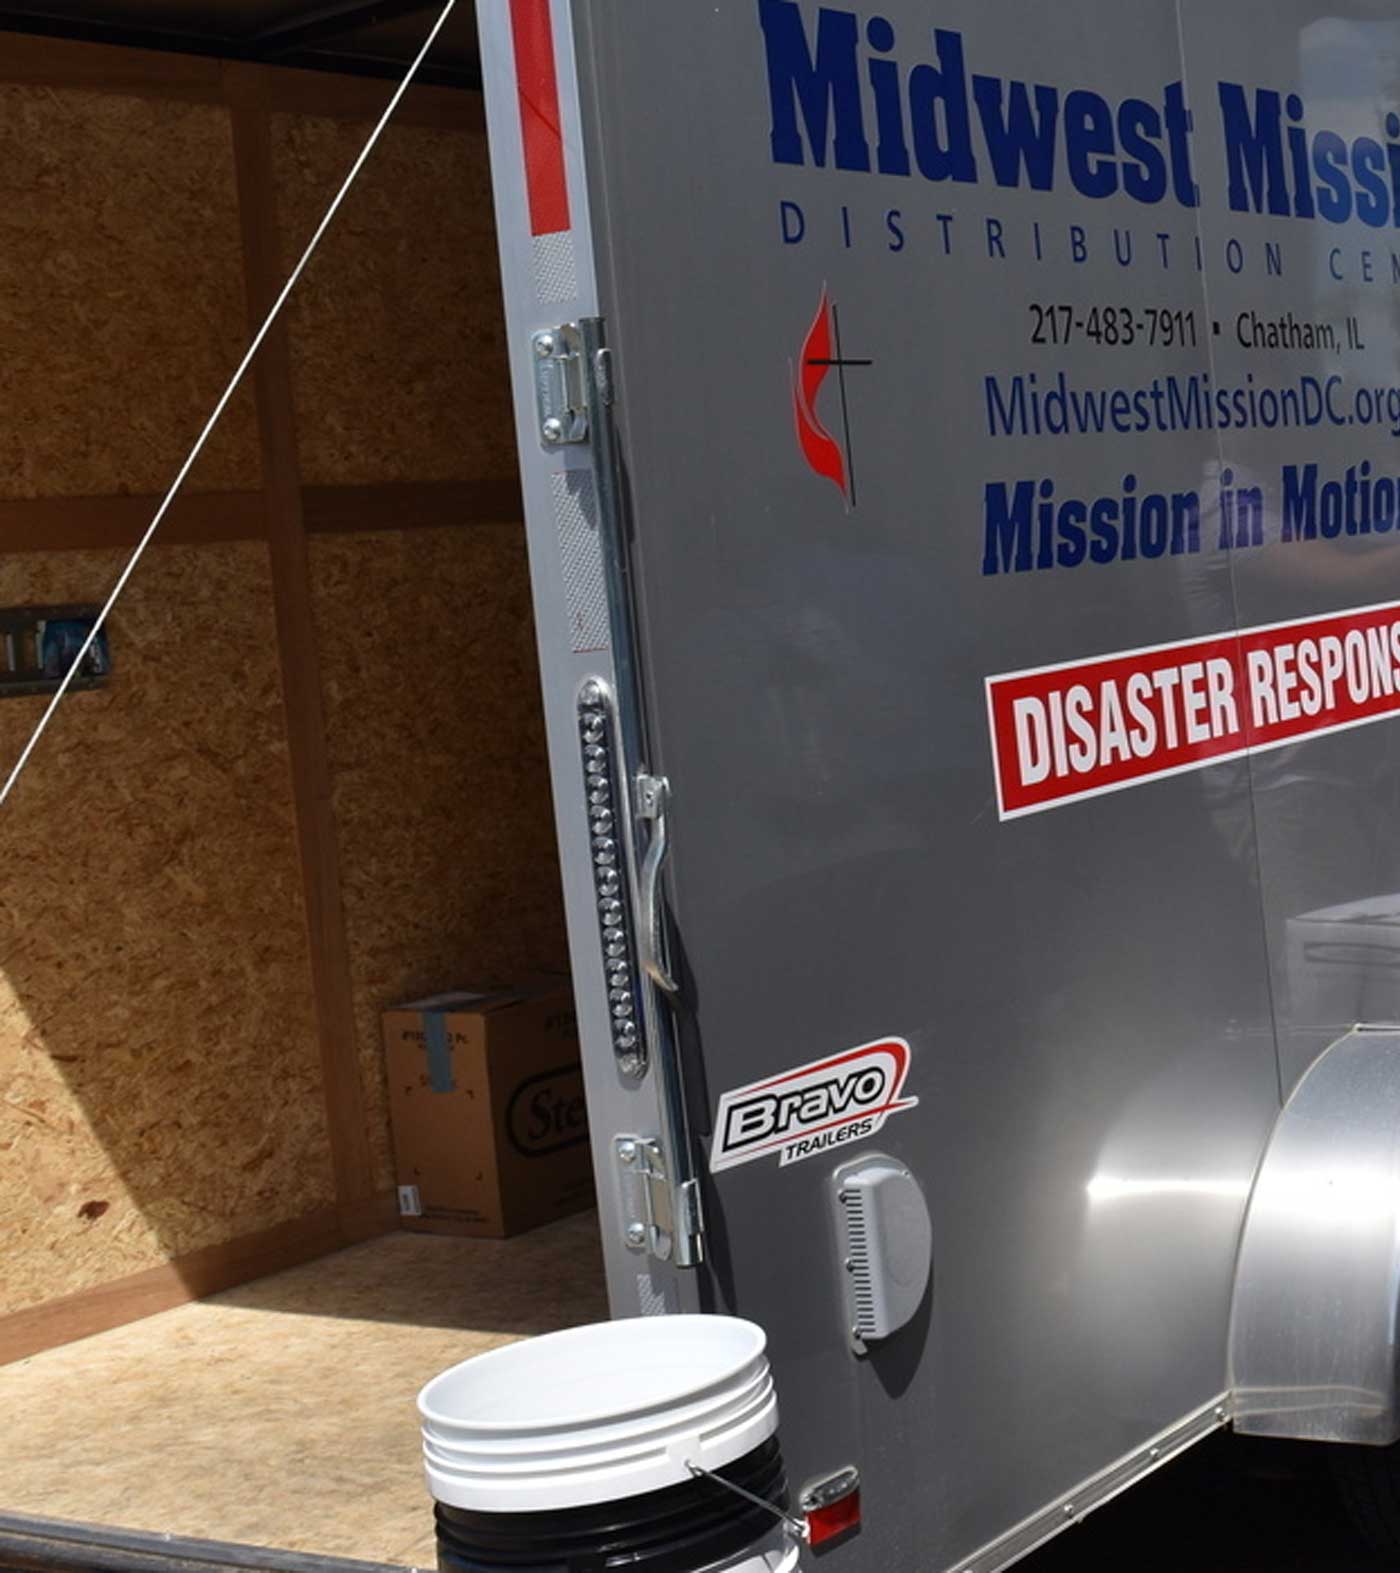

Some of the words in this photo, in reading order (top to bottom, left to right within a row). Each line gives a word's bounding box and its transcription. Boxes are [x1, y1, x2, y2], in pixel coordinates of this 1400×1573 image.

[758, 0, 1200, 208] Midwest
[780, 201, 1282, 276] DISTRIBUTION
[1029, 303, 1197, 348] 217-483-7911
[1236, 311, 1341, 355] Chatham,
[1347, 317, 1365, 351] IL
[982, 474, 1200, 576] Mission
[1218, 468, 1264, 550] in
[1013, 657, 1240, 787] DISASTER
[722, 1066, 886, 1152] Bravo
[787, 1118, 873, 1160] TRAILERS
